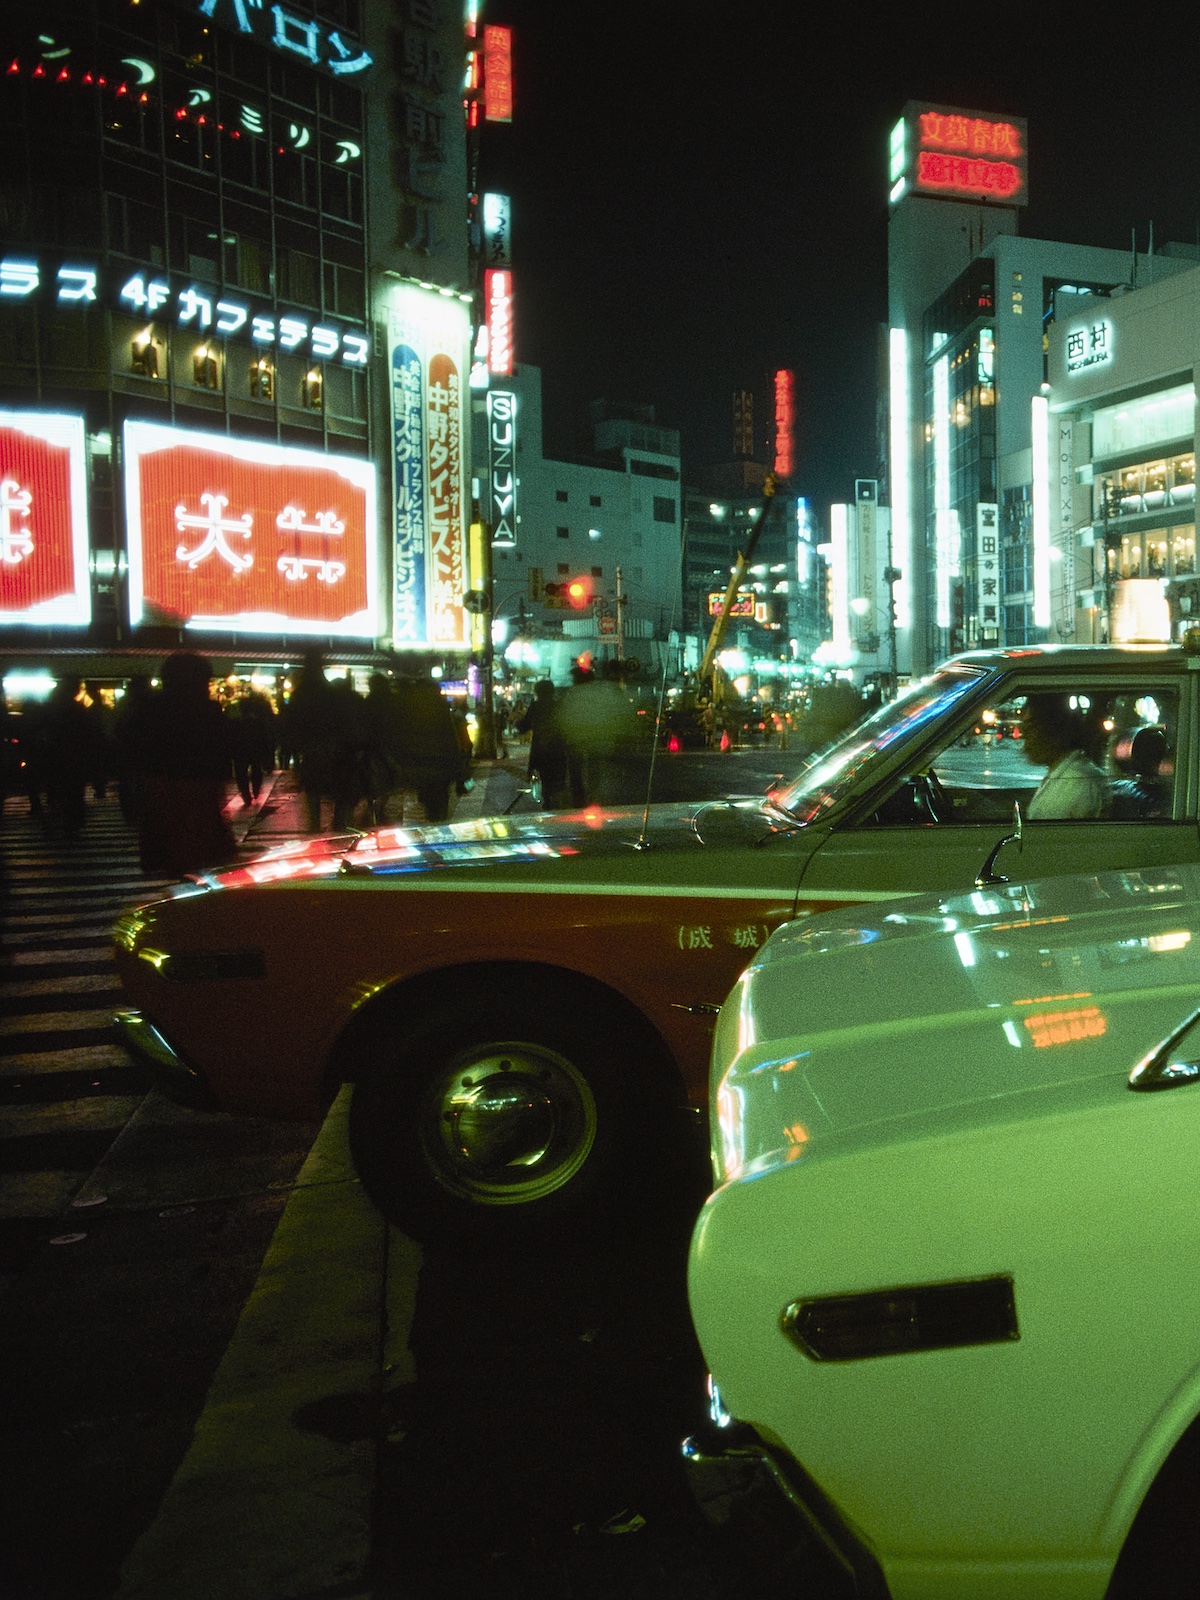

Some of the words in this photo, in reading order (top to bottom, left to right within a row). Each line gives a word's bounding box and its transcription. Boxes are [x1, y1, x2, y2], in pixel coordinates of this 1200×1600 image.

[1067, 322, 1107, 359] 西村
[1067, 352, 1109, 372] NISHIMURA
[493, 398, 514, 539] SUZUYA
